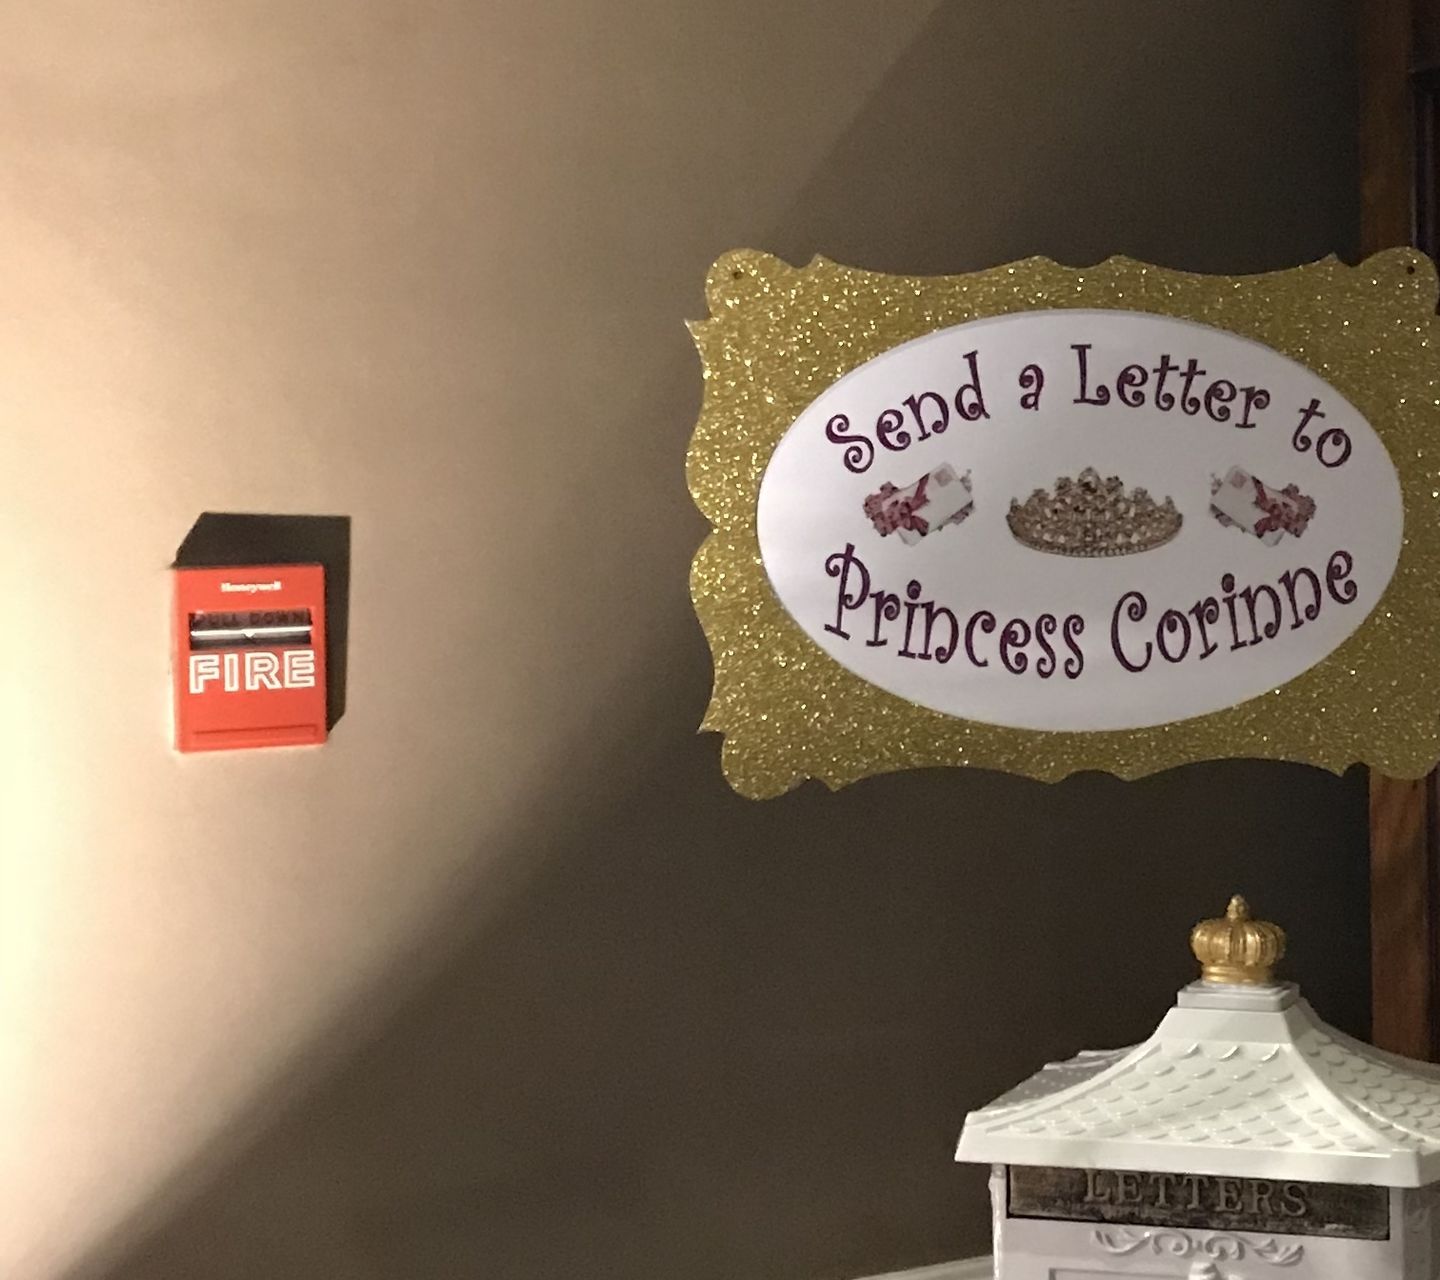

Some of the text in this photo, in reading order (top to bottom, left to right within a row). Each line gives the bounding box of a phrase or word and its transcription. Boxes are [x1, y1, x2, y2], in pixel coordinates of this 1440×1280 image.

[824, 344, 1354, 474] Send a Letter to
[823, 542, 1359, 679] Princess Corinne
[188, 649, 316, 695] FIRE
[1084, 1168, 1308, 1217] LETTERS
